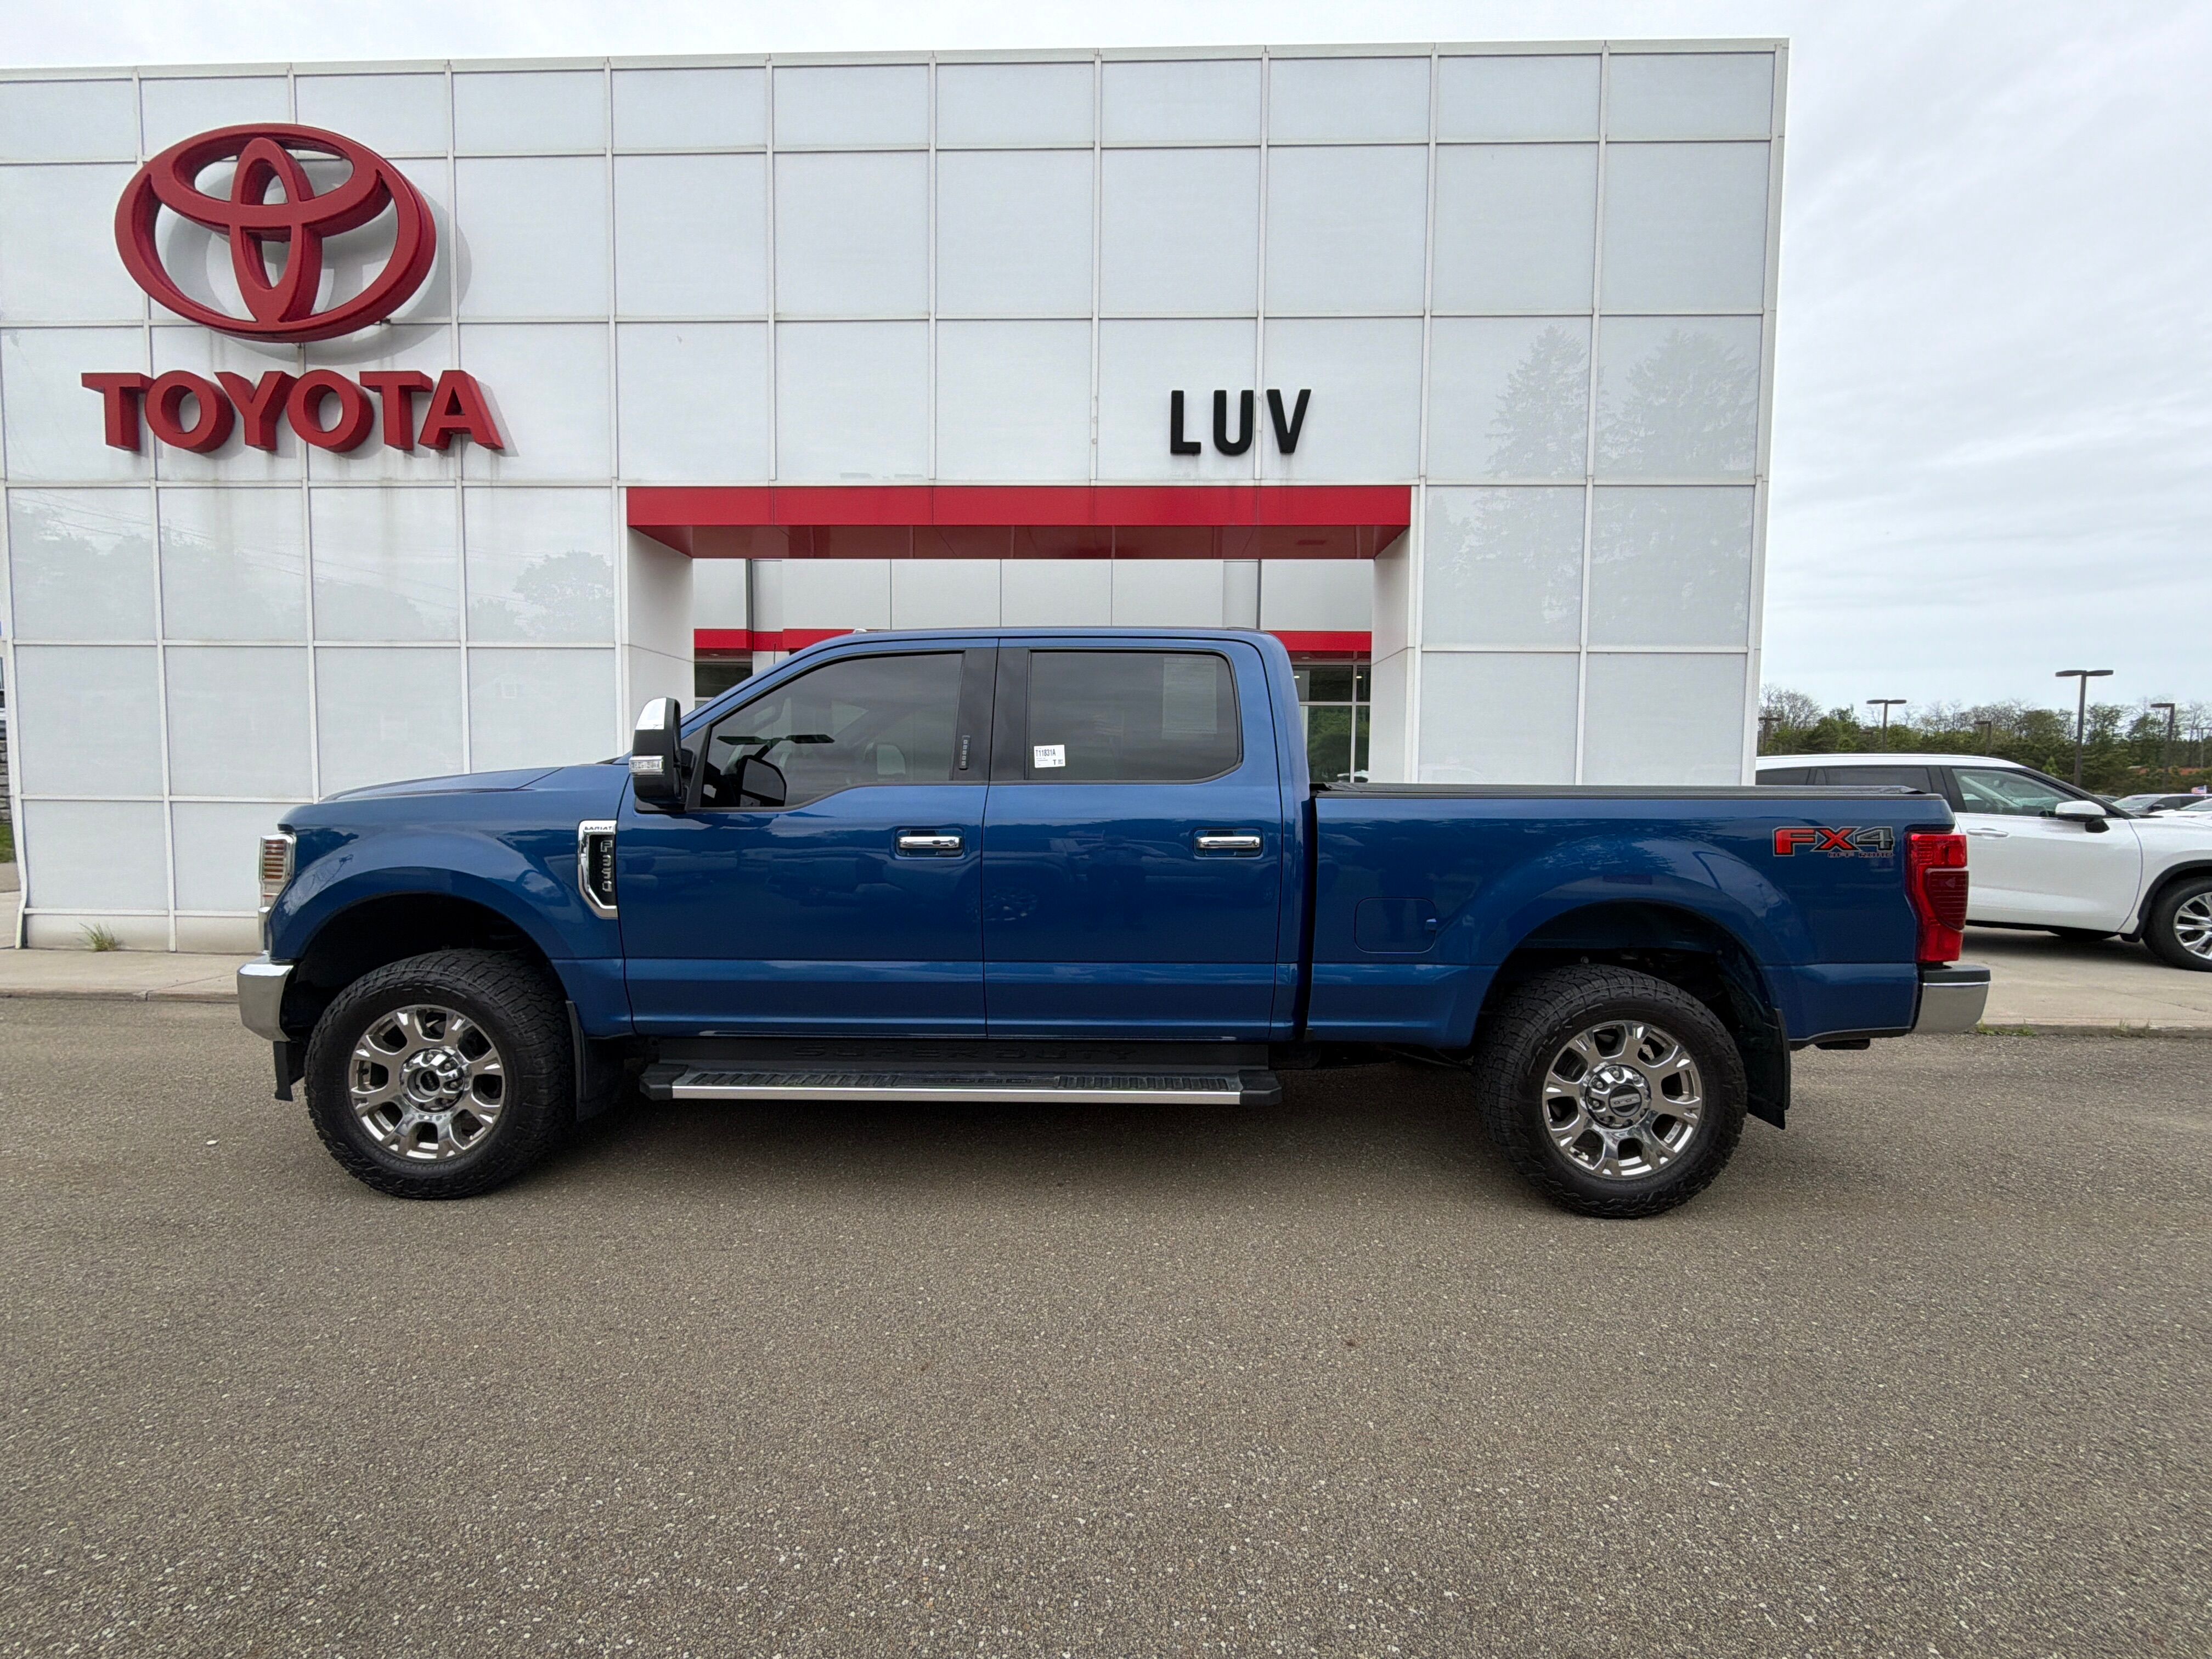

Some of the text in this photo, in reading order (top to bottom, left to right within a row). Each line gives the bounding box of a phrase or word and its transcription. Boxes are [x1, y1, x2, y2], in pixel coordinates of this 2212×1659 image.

[81, 369, 504, 453] TOYOTA
[1170, 389, 1311, 455] LUV
[1773, 826, 1895, 856] FX4
